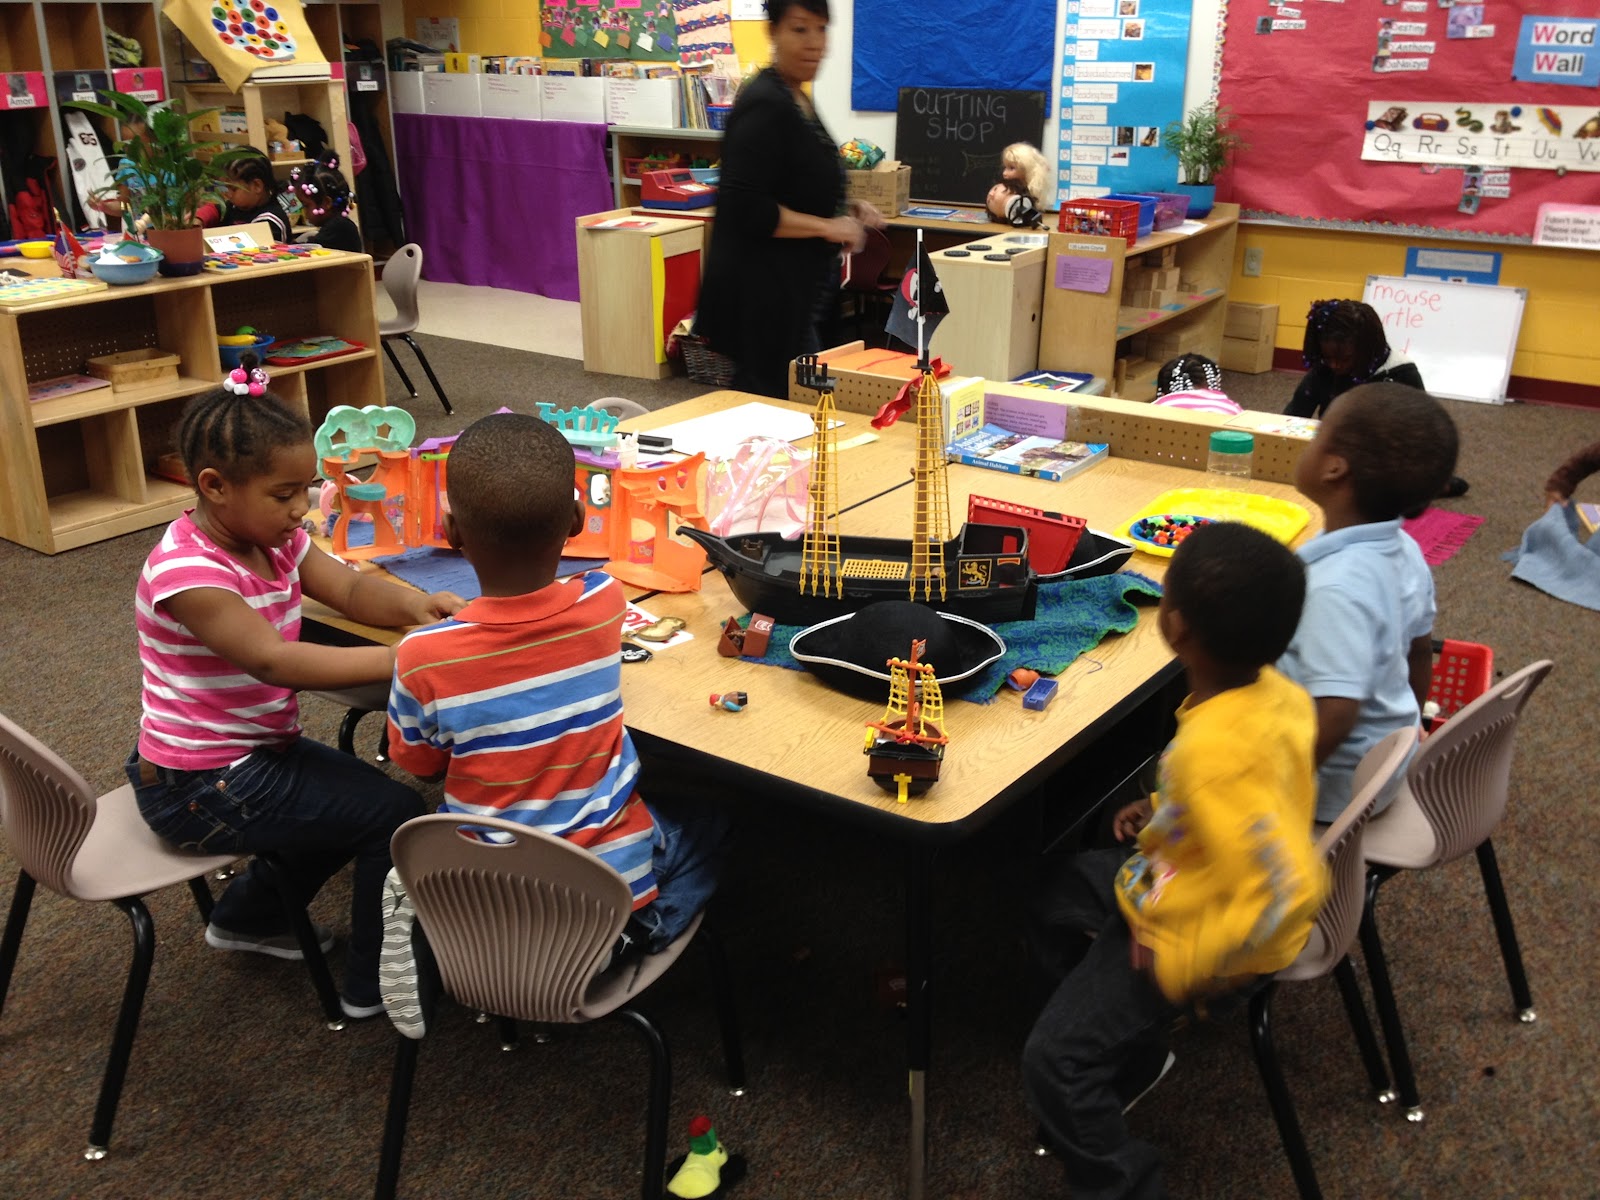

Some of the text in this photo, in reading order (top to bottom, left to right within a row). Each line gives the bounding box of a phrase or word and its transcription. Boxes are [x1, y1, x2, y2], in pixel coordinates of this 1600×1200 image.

[1274, 20, 1305, 29] Andrew
[1534, 25, 1596, 44] Word
[1536, 53, 1584, 73] Wall
[358, 82, 376, 90] Tyrone
[10, 97, 33, 106] Amon
[913, 89, 1007, 123] CUTTING
[1074, 109, 1095, 121] Lunch
[927, 117, 994, 143] SHOP
[1374, 133, 1404, 160] Qq
[1417, 135, 1443, 154] Rr
[1456, 136, 1478, 156] Ss
[1493, 137, 1511, 157] Tt
[1532, 140, 1558, 160] Uu
[1482, 188, 1509, 196] yrone
[1373, 284, 1441, 312] mouse
[1382, 306, 1424, 329] rtle
[971, 459, 1009, 471] Animal Habitats
